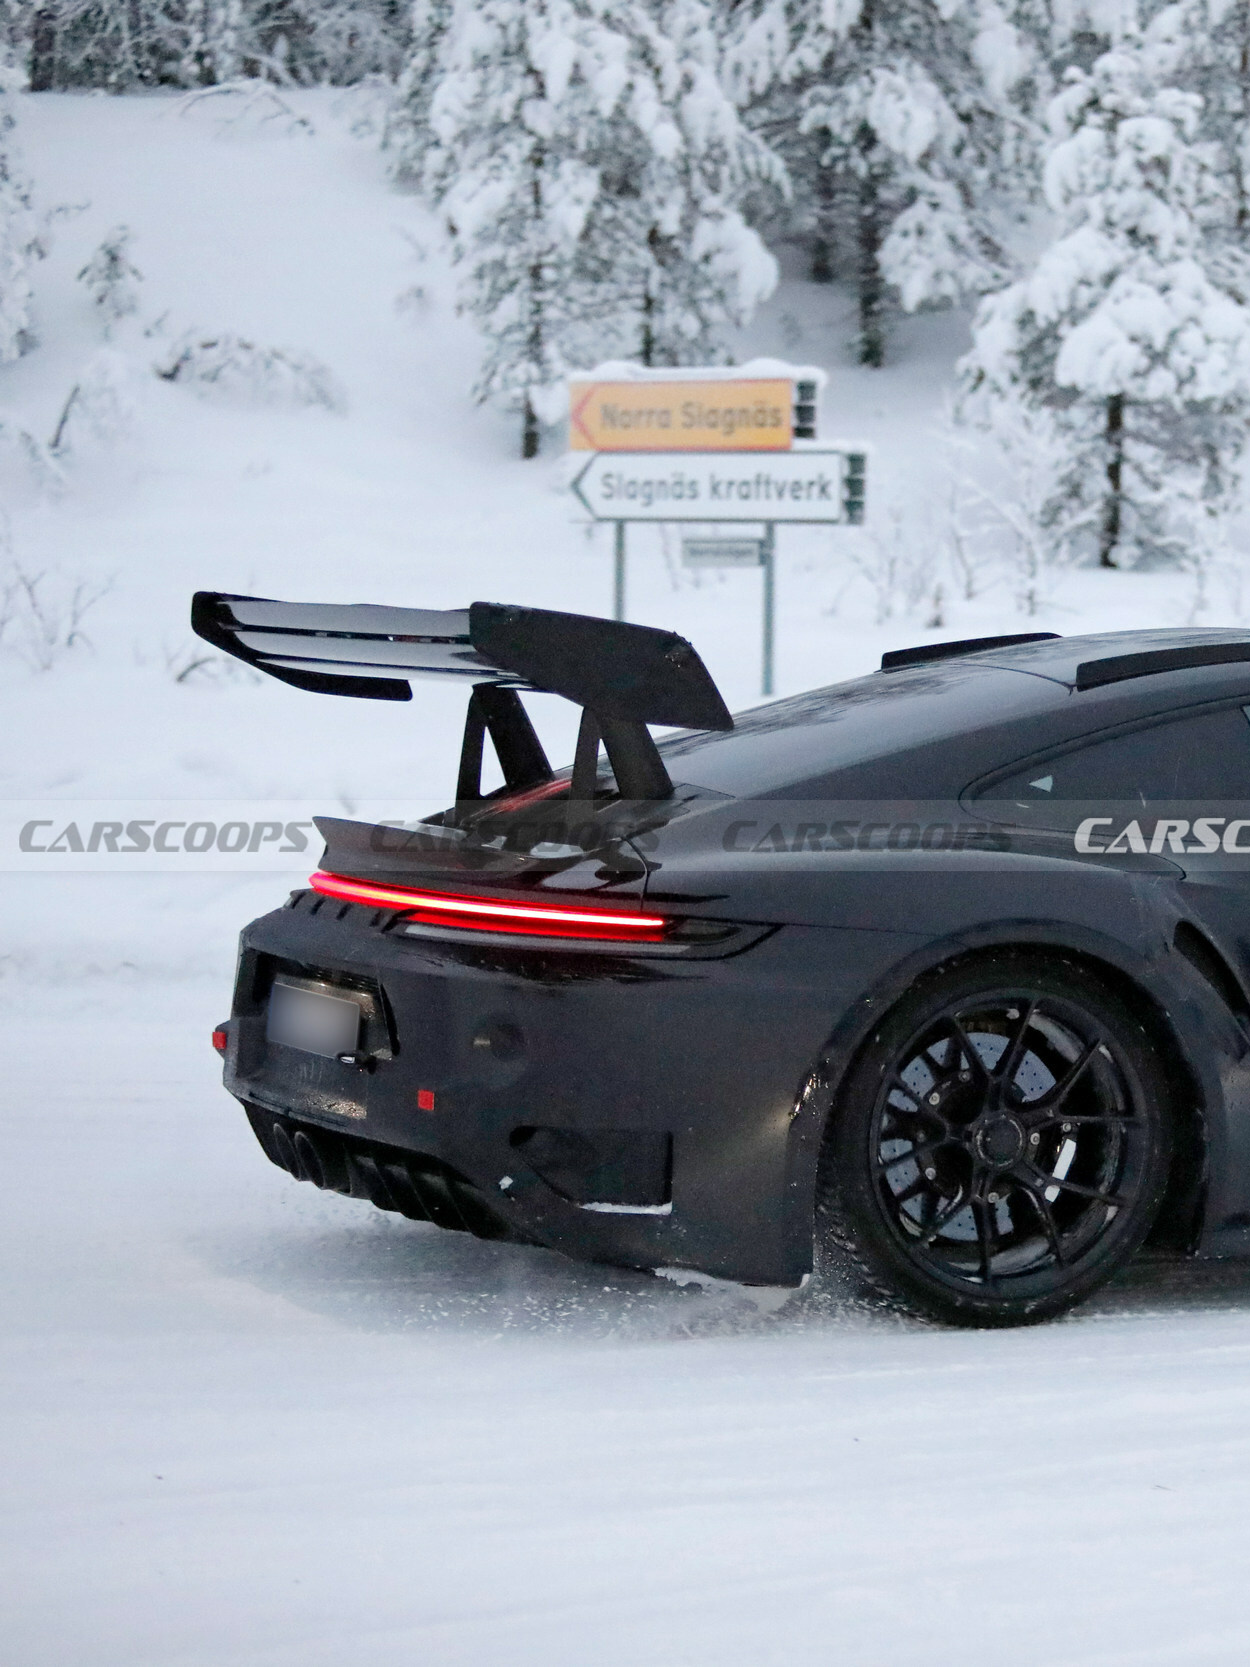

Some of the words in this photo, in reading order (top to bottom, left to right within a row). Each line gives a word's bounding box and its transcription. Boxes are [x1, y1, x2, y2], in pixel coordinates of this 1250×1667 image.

[601, 403, 671, 428] Norra
[681, 400, 783, 435] Slagnäs
[600, 472, 699, 507] Slagnäs
[710, 473, 832, 500] kraftverk
